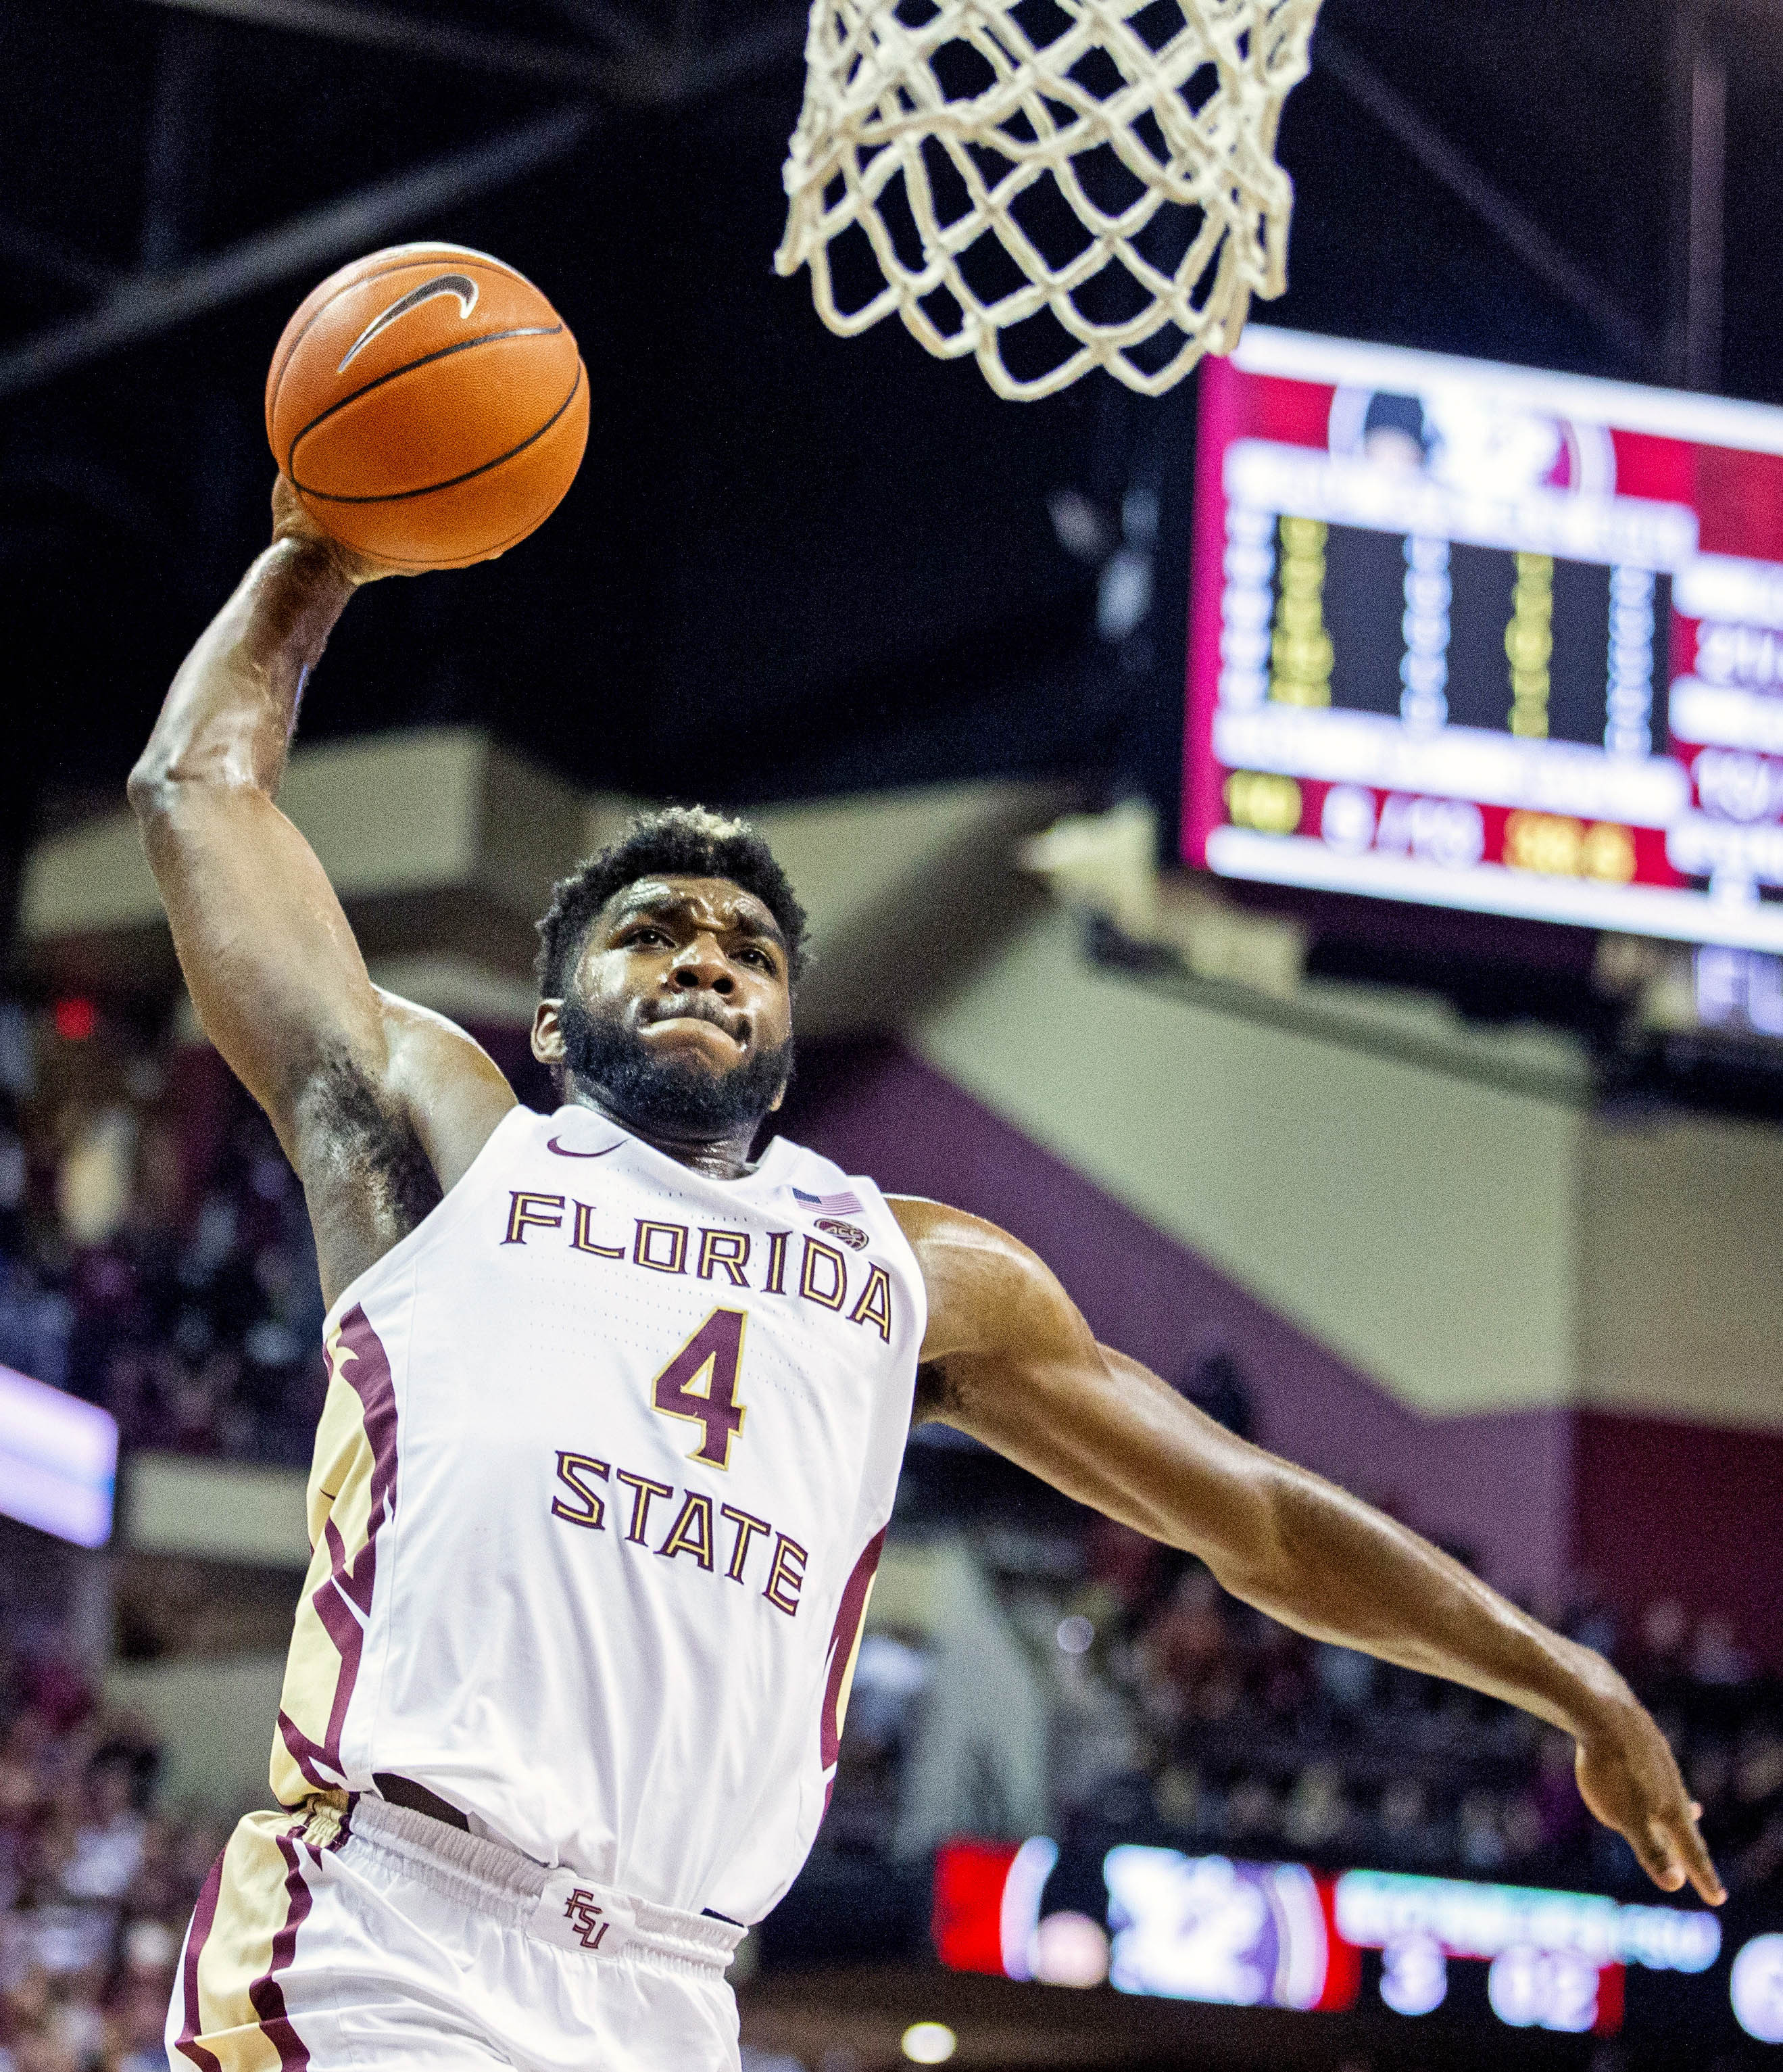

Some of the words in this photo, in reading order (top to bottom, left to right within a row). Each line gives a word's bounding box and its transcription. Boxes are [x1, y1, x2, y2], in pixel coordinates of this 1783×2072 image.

[500, 1190, 891, 1345] FLORIDA
[652, 1306, 748, 1472] 4
[551, 1449, 809, 1617] STATE
[563, 1888, 610, 1950] FSU
